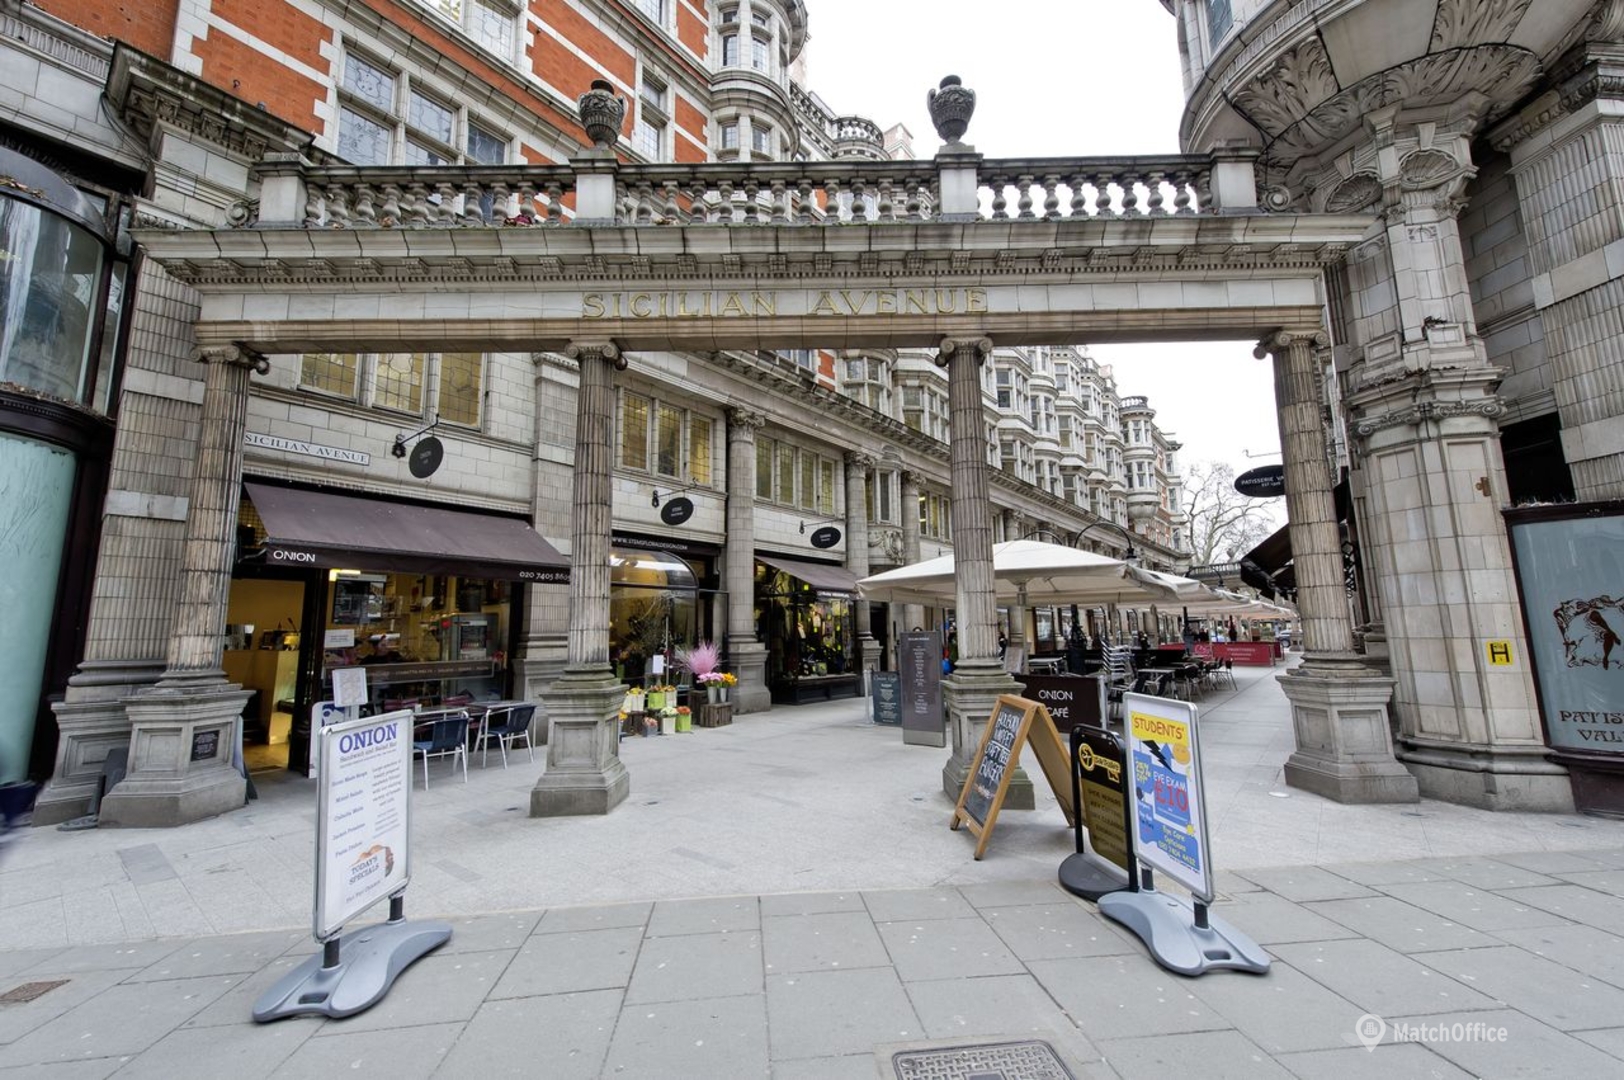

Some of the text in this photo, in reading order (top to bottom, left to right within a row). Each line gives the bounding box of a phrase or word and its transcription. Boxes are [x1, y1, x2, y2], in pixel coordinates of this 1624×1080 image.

[582, 288, 988, 318] SICILIAN AVENUE
[245, 433, 369, 463] SICILIAN AVENUE
[273, 550, 316, 562] ONION
[1490, 643, 1510, 663] H
[1038, 689, 1073, 701] ONION
[1046, 706, 1069, 718] CAFÉ
[1559, 710, 1624, 724] PATIS
[340, 723, 398, 754] ONION
[1577, 729, 1624, 743] VAL
[1154, 779, 1189, 812] £10
